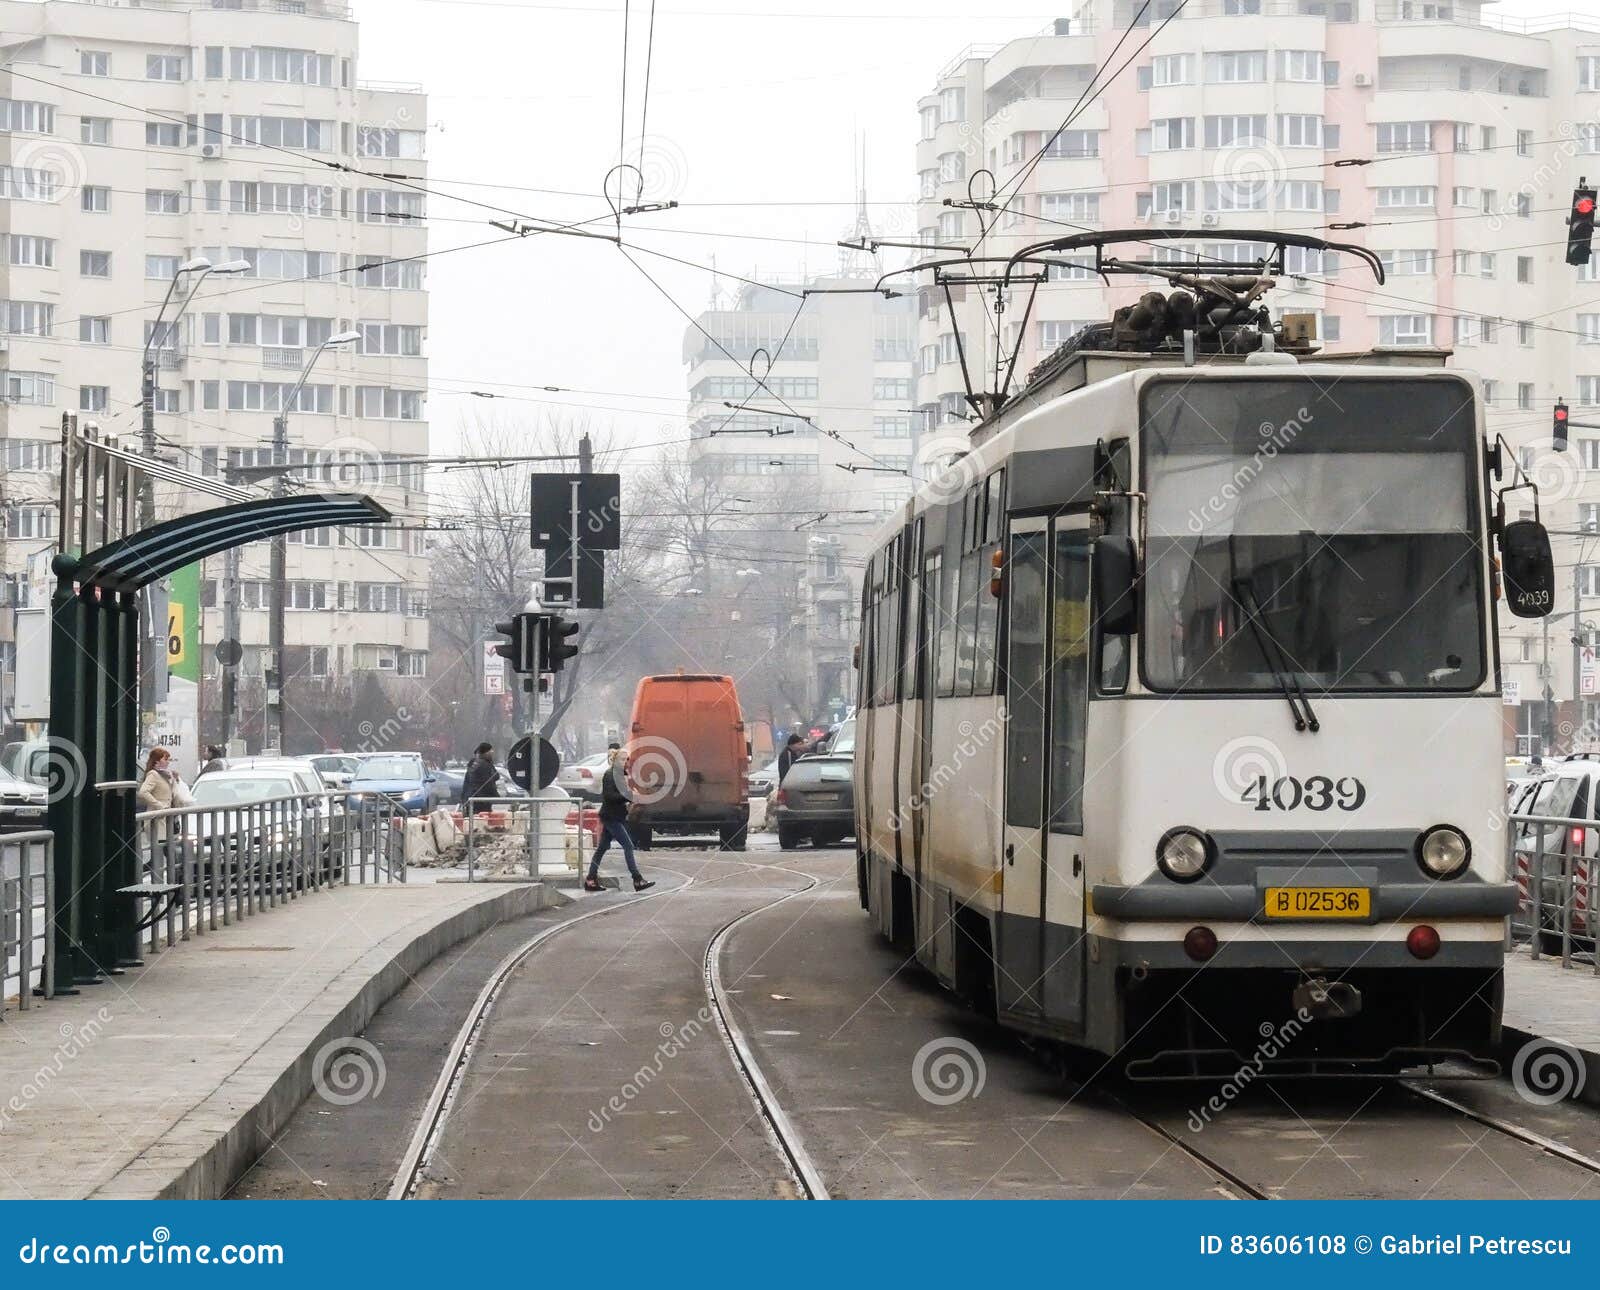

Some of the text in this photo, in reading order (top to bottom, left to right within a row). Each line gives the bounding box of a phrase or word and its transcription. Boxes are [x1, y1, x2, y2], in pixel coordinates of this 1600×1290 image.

[1517, 590, 1550, 606] 4039
[1241, 775, 1366, 811] 4039
[1278, 892, 1360, 911] B 02536
